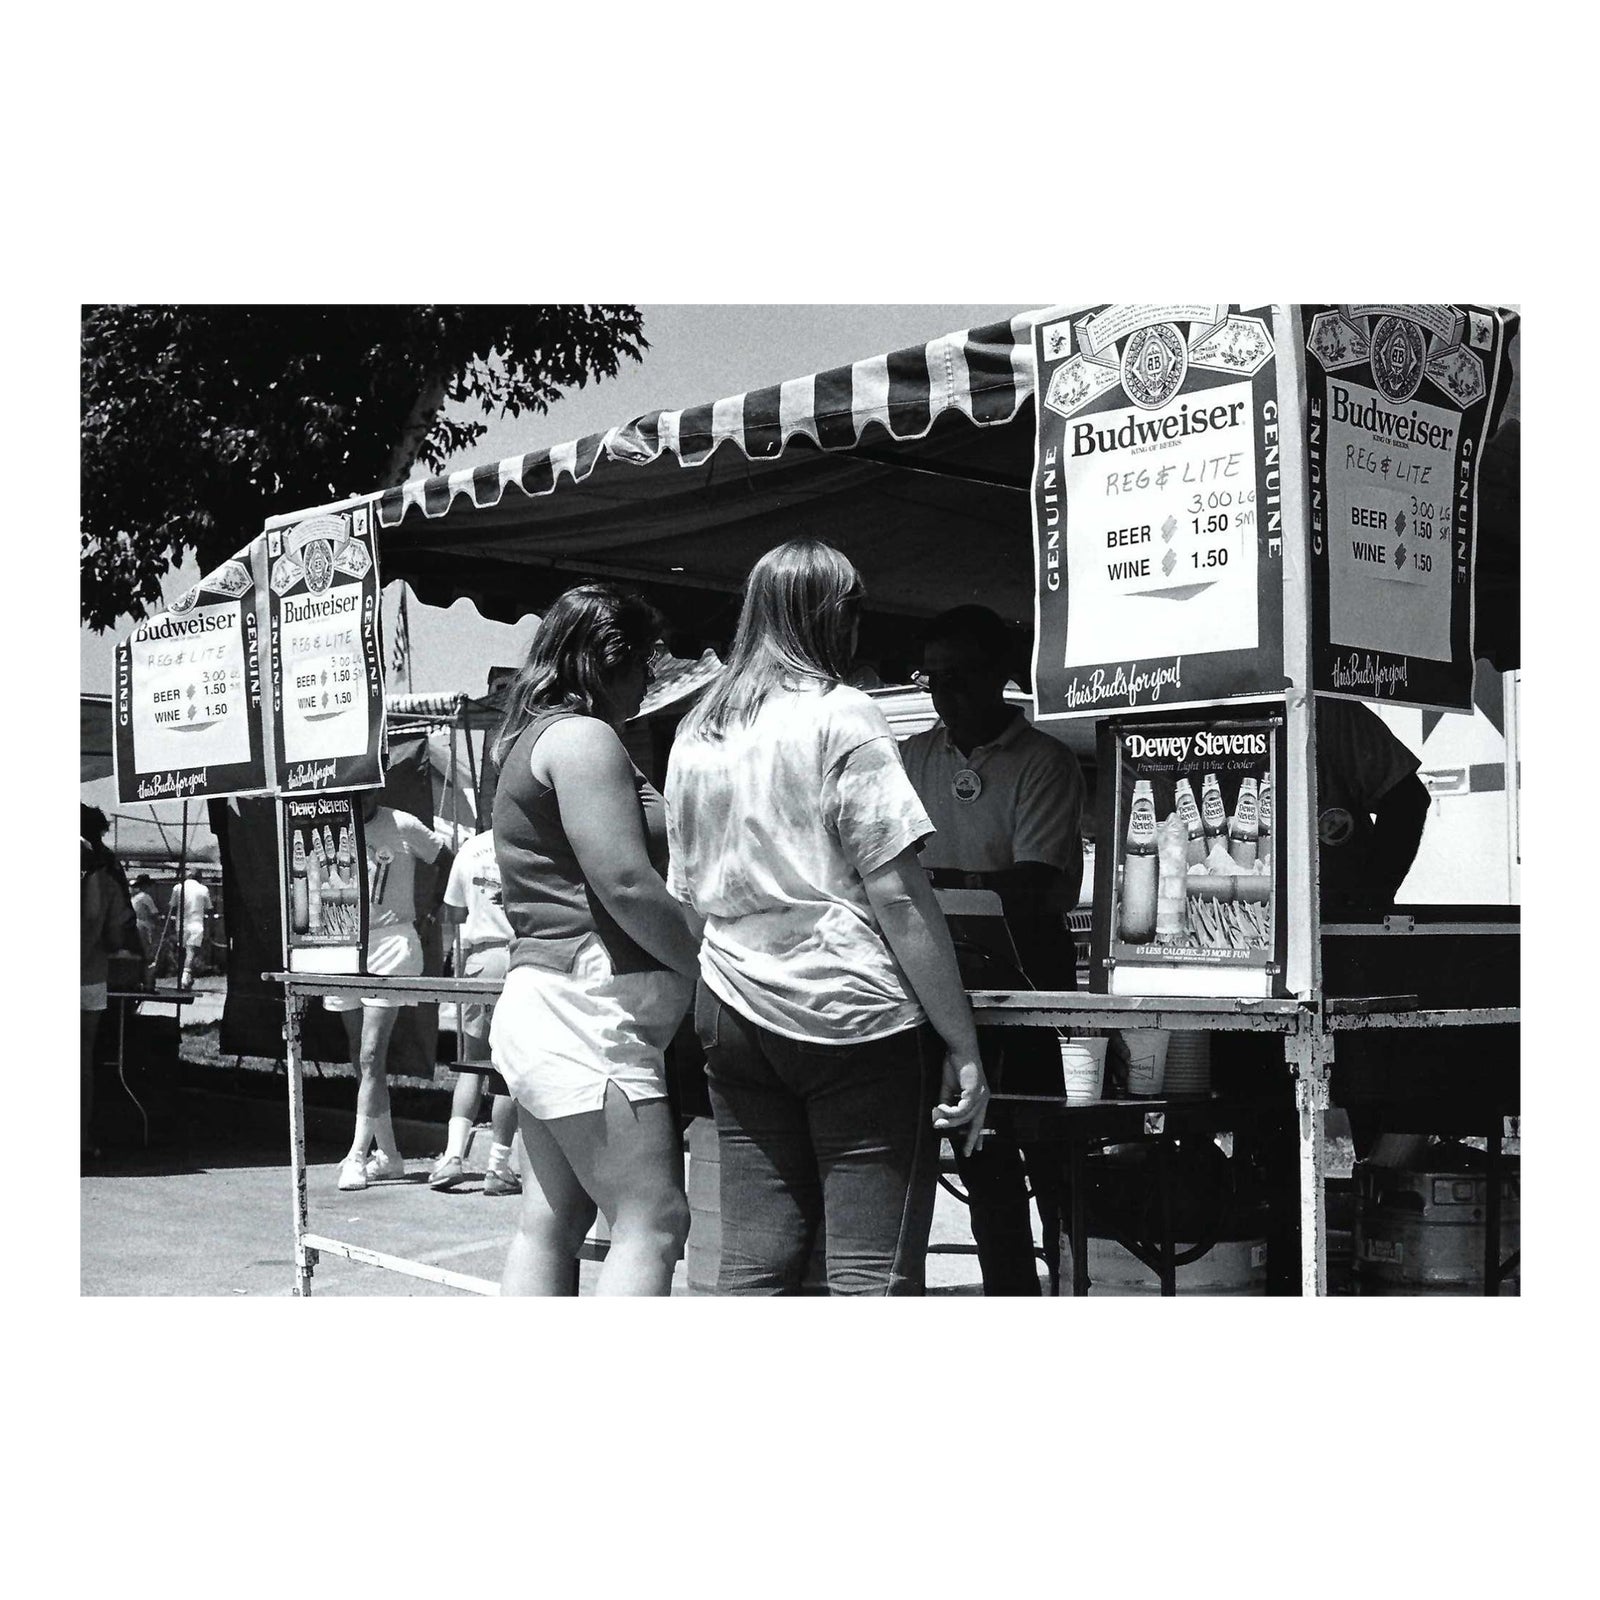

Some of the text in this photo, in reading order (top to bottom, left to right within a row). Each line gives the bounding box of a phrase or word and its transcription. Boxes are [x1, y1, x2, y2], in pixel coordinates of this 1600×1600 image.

[1071, 401, 1245, 457] Budweiser
[1332, 386, 1453, 451] Budweiser
[1106, 469, 1150, 496] REG
[1182, 452, 1244, 484] LITE
[1263, 400, 1282, 559] GENUINE
[1310, 398, 1322, 555] GENUINE
[1346, 444, 1376, 474] REG
[1397, 461, 1432, 484] LITE
[1187, 490, 1232, 514] 3.00
[1410, 495, 1435, 520] 3.00
[1457, 438, 1473, 584] GENUINE
[1043, 446, 1060, 591] GENUINE
[1107, 524, 1152, 548] BEER
[1191, 514, 1228, 535] 1.50
[1351, 506, 1388, 530] BEER
[1412, 520, 1432, 539] 1.50
[1107, 548, 1228, 581] WINE 1.50
[1352, 541, 1432, 573] WINE 1.50
[284, 594, 359, 624] Budweiser
[135, 612, 236, 643] Budweiser
[190, 645, 227, 663] LITE
[247, 612, 261, 708] GENUINE
[365, 595, 379, 697] GENUINE
[153, 689, 180, 703] BEER
[204, 682, 226, 695] 1.50
[296, 674, 316, 688] BEER
[333, 669, 350, 682] 1.50
[155, 703, 227, 723] WINE 1.50
[297, 691, 352, 709] WINE 1.50
[1125, 734, 1192, 762] Dewey
[1137, 759, 1255, 774] Premium Light Wine Cooler
[289, 799, 350, 819] Dewey Stevens
[1145, 947, 1161, 955] LESS
[1211, 949, 1232, 958] MORE
